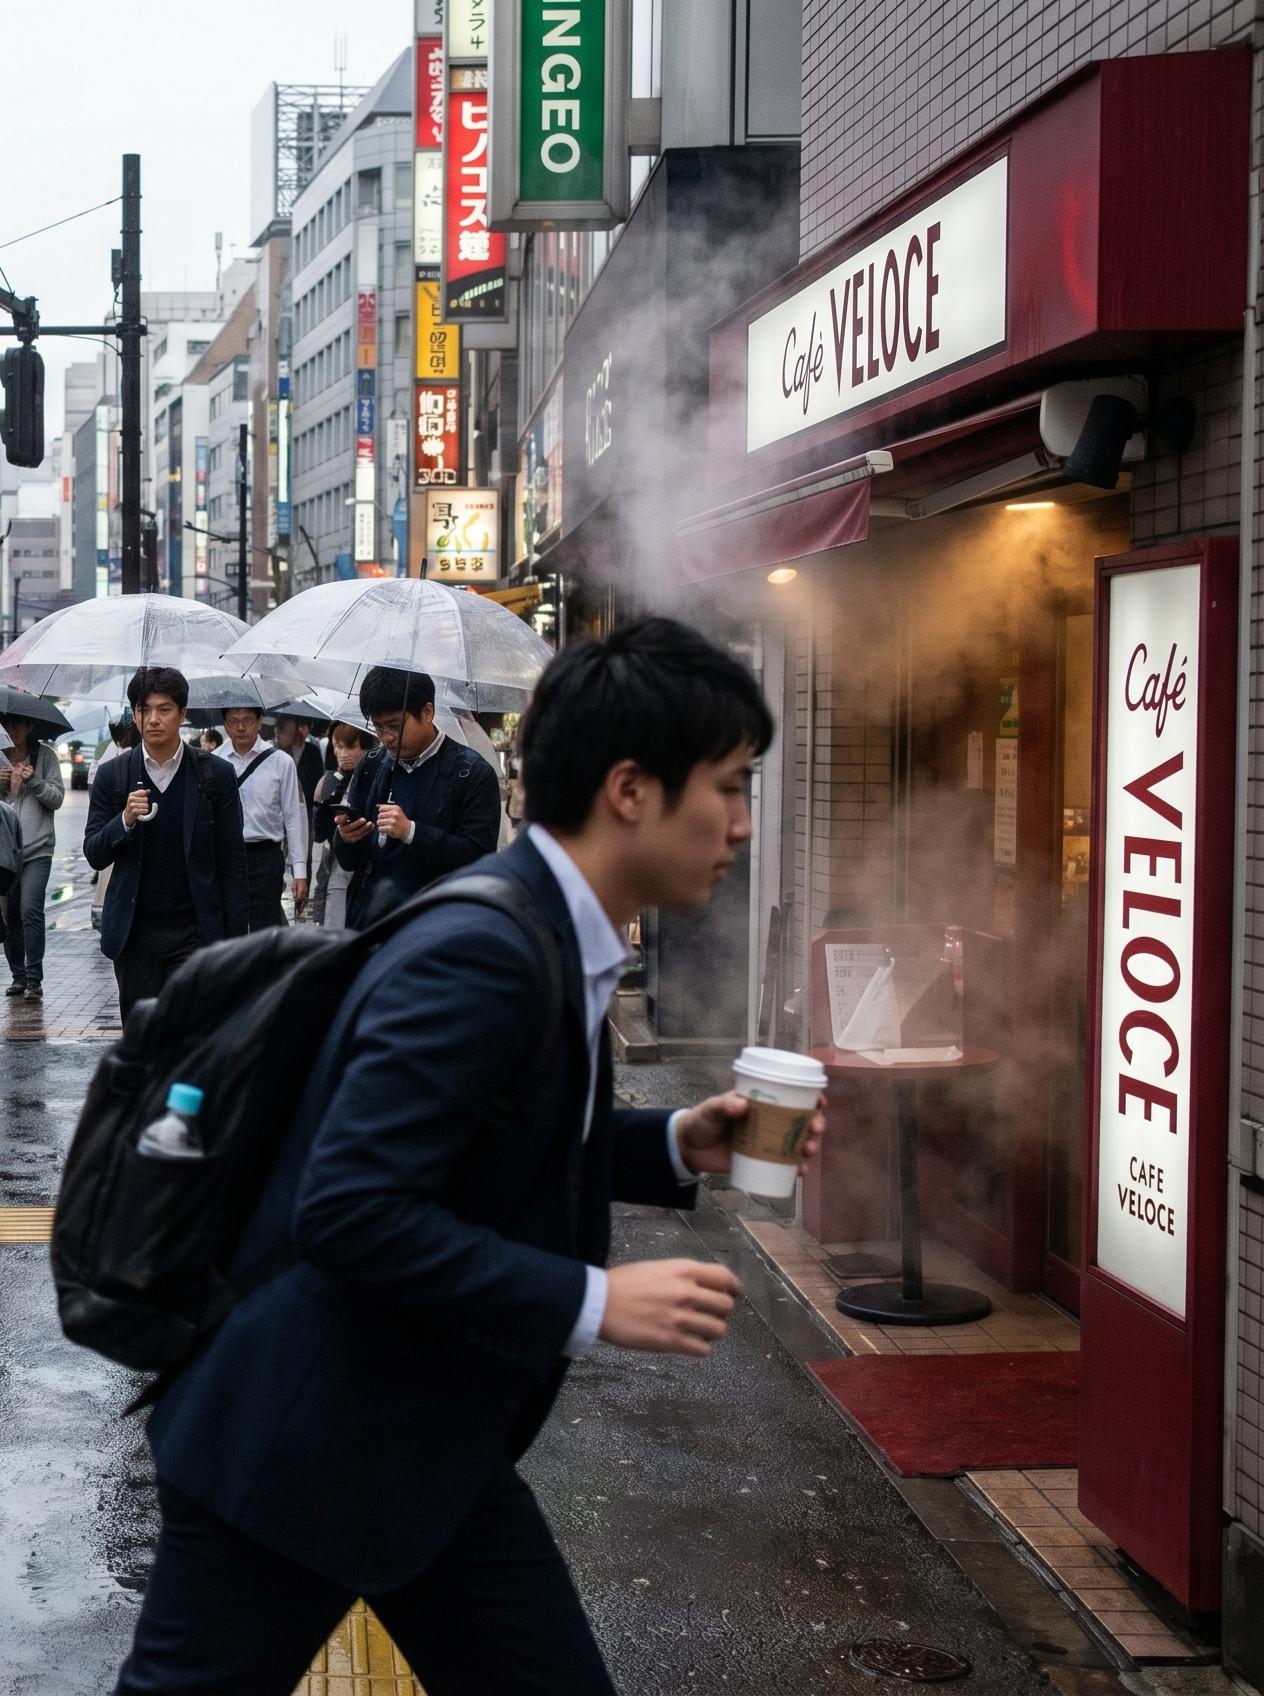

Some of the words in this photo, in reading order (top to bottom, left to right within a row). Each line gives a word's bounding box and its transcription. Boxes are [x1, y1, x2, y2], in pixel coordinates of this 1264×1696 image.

[540, 0, 582, 174] NGEO
[829, 220, 942, 398] VELOCE
[1124, 642, 1188, 738] Café
[1117, 750, 1184, 1136] VELOCE
[1117, 1183, 1175, 1236] VELOCE
[1129, 1155, 1164, 1194] CAFE
